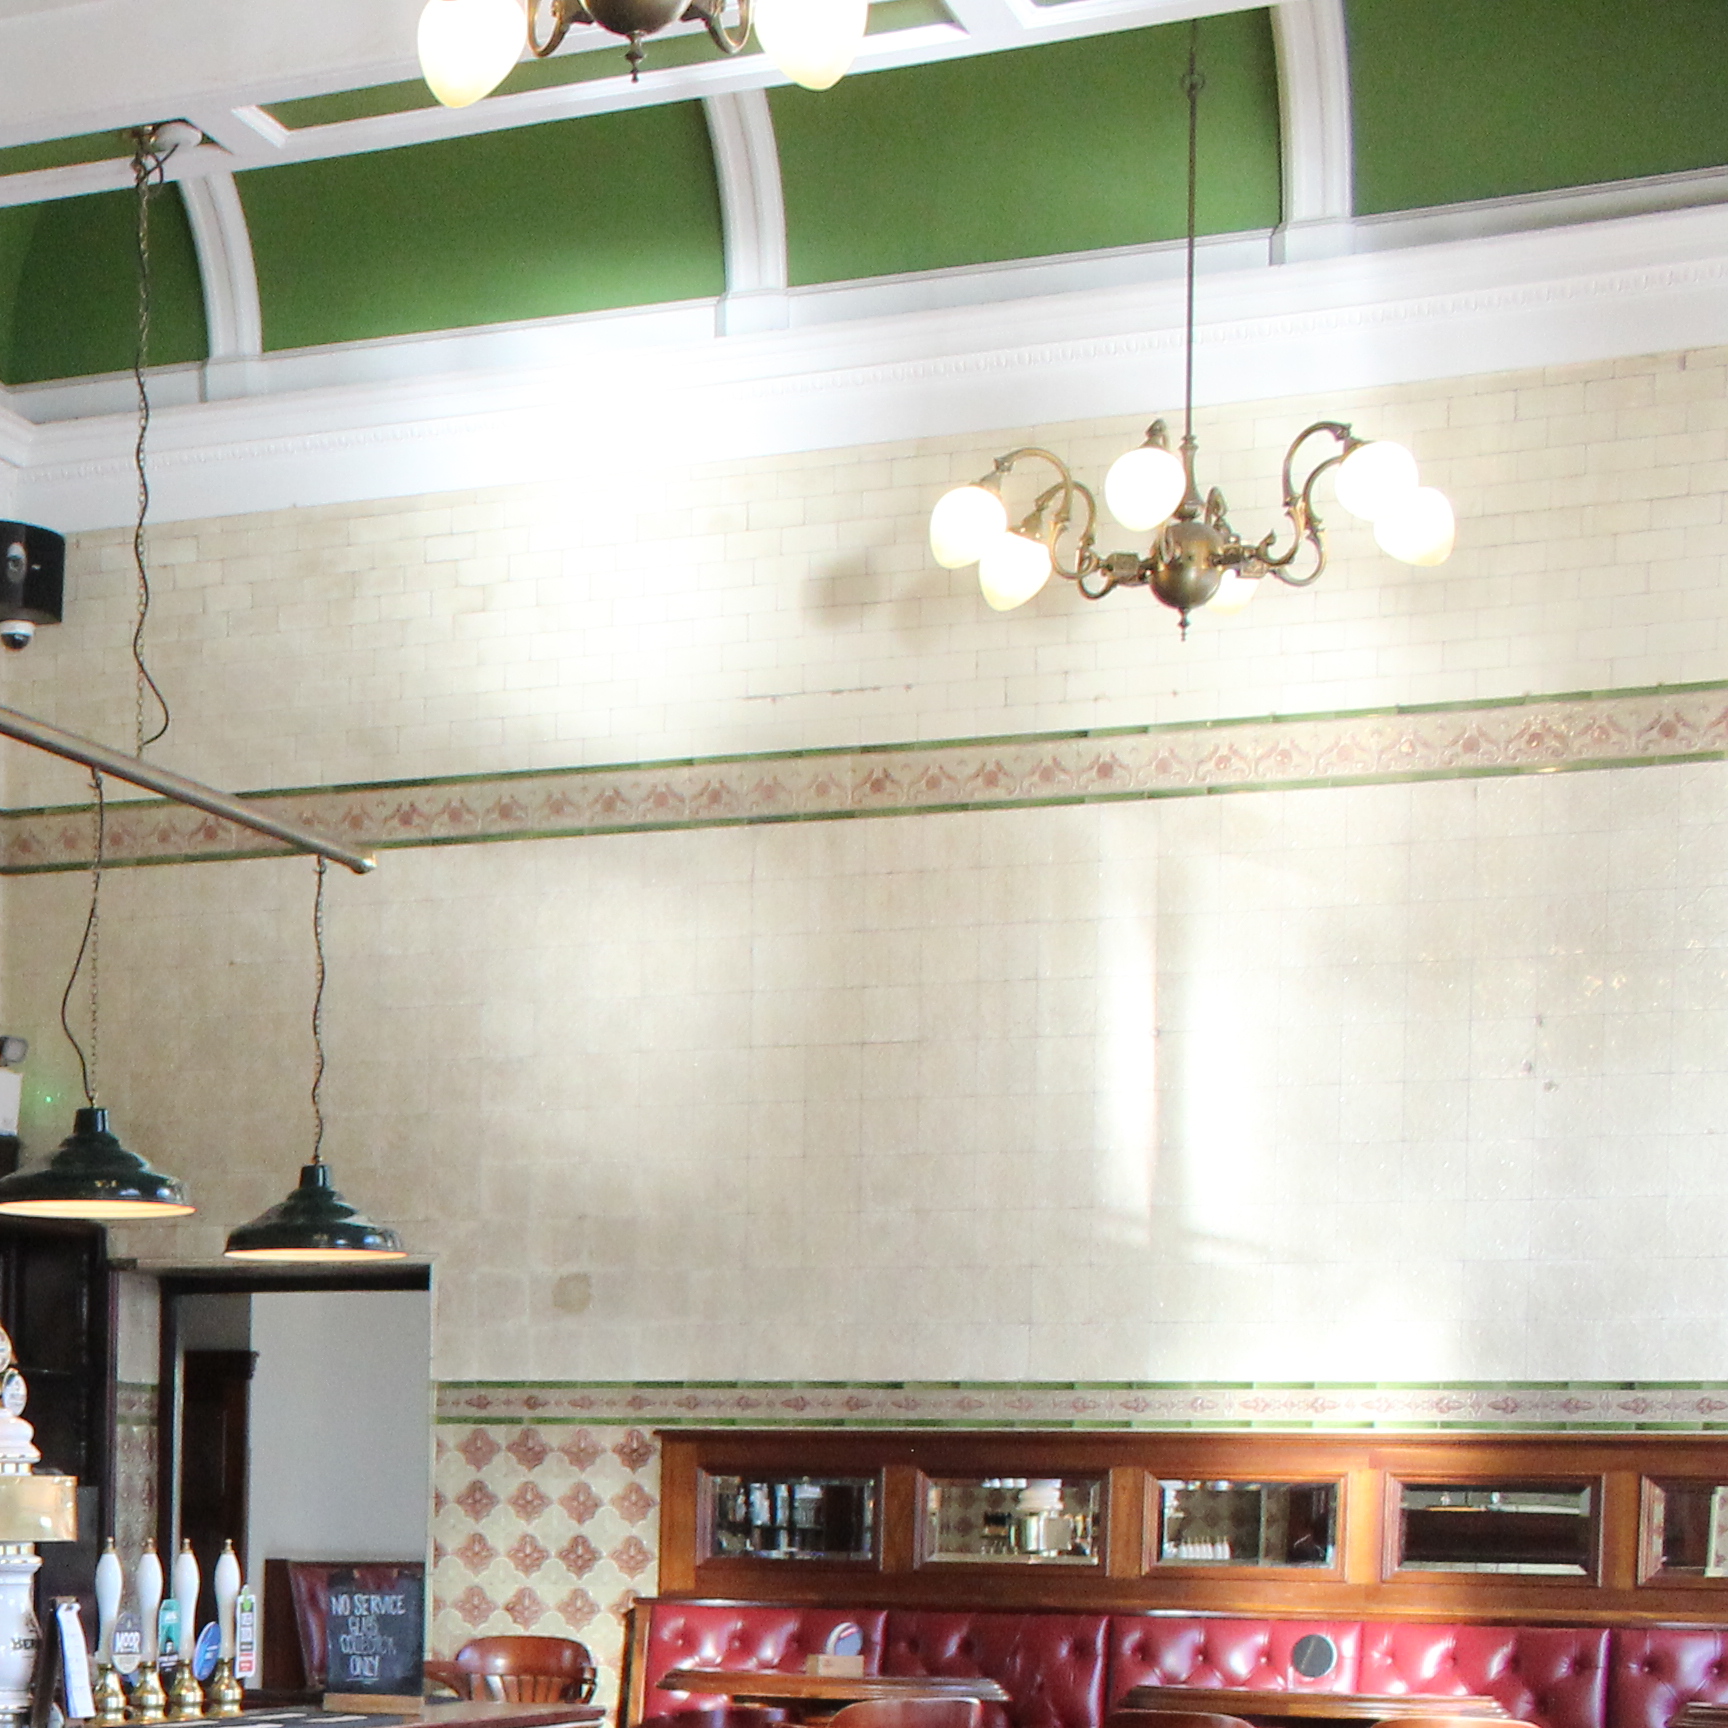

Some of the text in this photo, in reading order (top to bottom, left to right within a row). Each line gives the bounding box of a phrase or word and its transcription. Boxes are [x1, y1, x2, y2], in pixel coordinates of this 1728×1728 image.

[330, 1593, 407, 1616] NO SERVICE
[350, 1655, 380, 1677] ONLY
